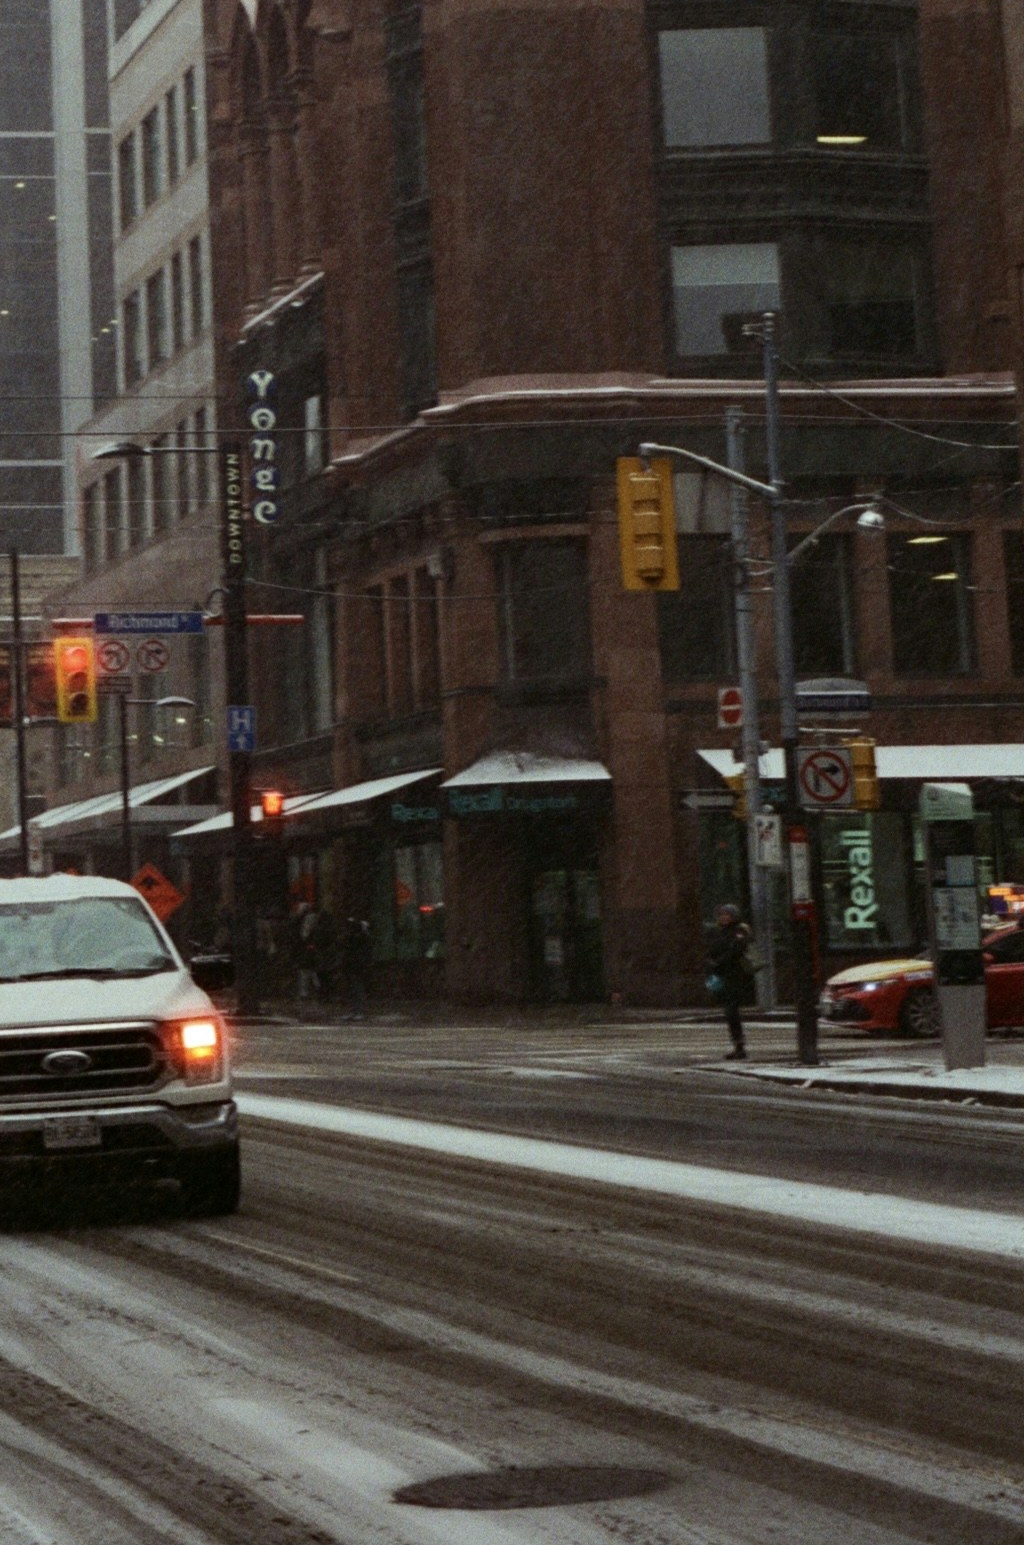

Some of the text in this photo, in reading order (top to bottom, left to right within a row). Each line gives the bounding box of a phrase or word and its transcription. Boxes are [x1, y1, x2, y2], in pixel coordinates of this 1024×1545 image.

[249, 370, 277, 524] Yonge
[227, 454, 242, 563] DOWNTOWN
[109, 614, 178, 629] Richmond
[231, 710, 251, 731] H
[840, 830, 878, 930] Rexall
